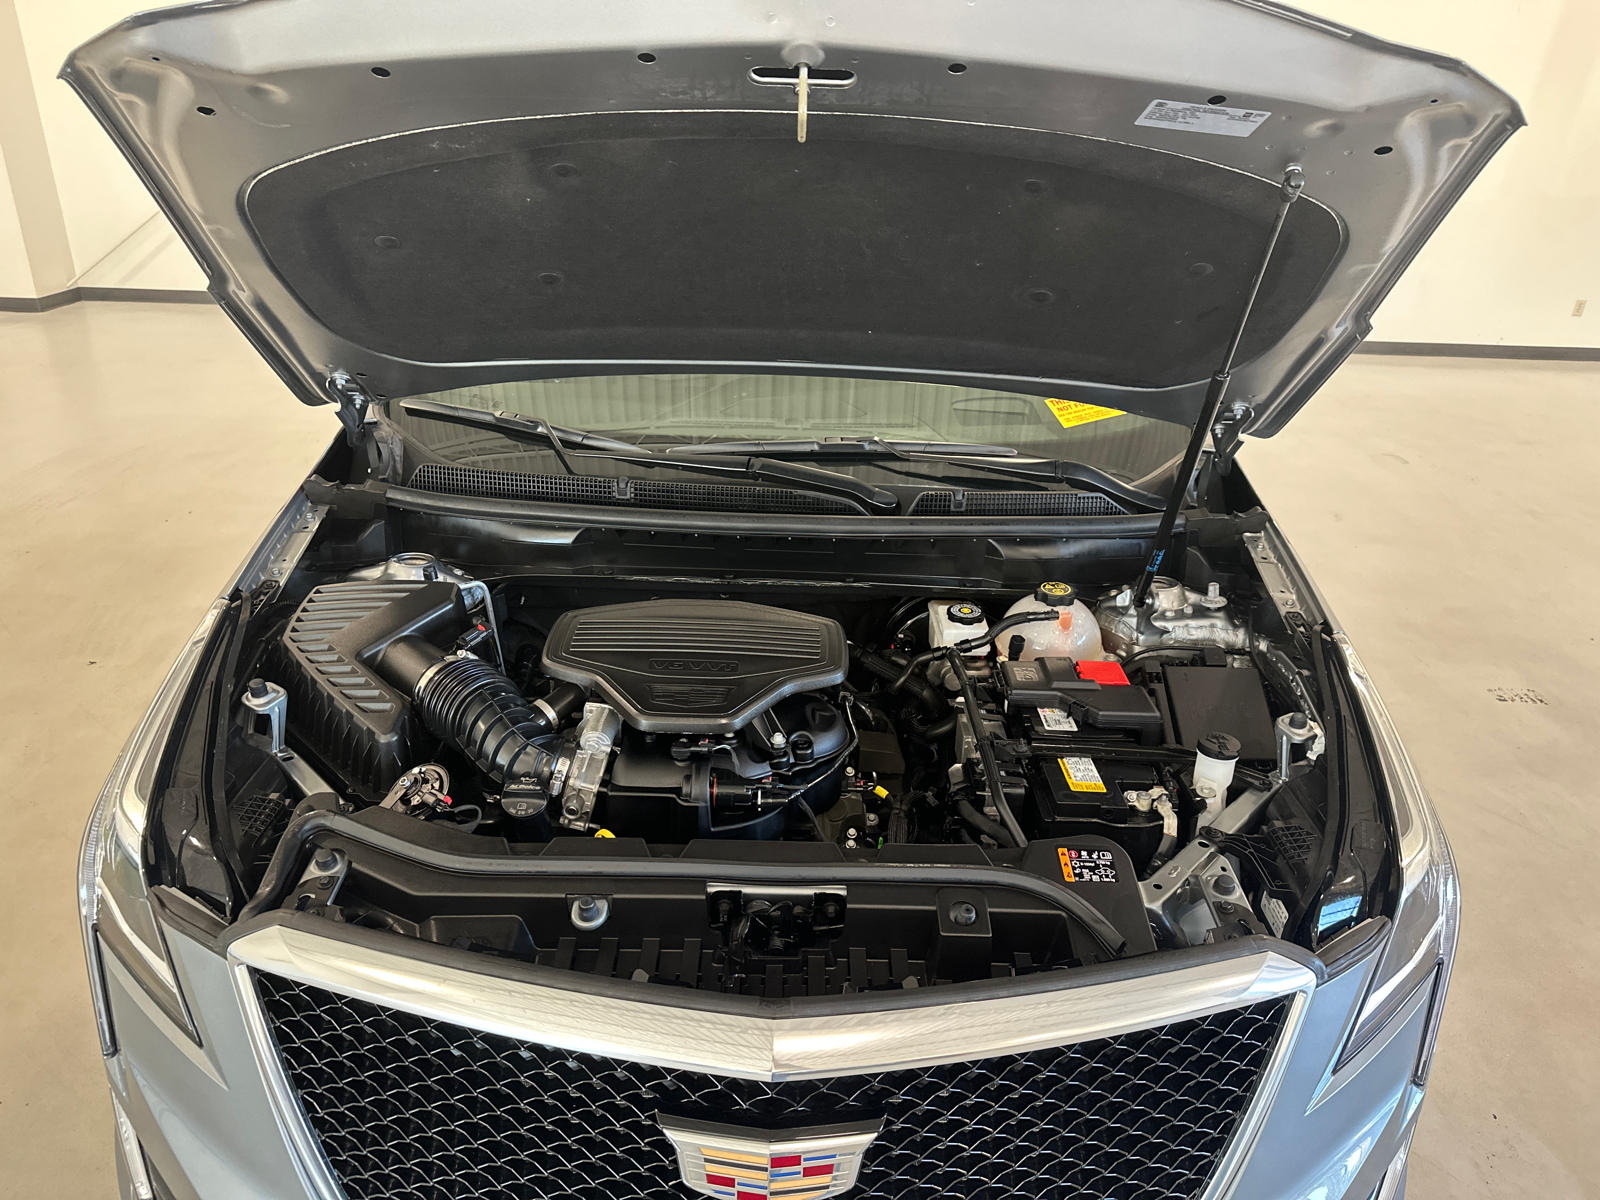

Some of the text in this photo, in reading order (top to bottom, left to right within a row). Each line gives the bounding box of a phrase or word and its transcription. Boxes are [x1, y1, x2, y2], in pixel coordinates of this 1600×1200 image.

[1057, 404, 1073, 412] NOT
[652, 661, 736, 671] V6 VVT
